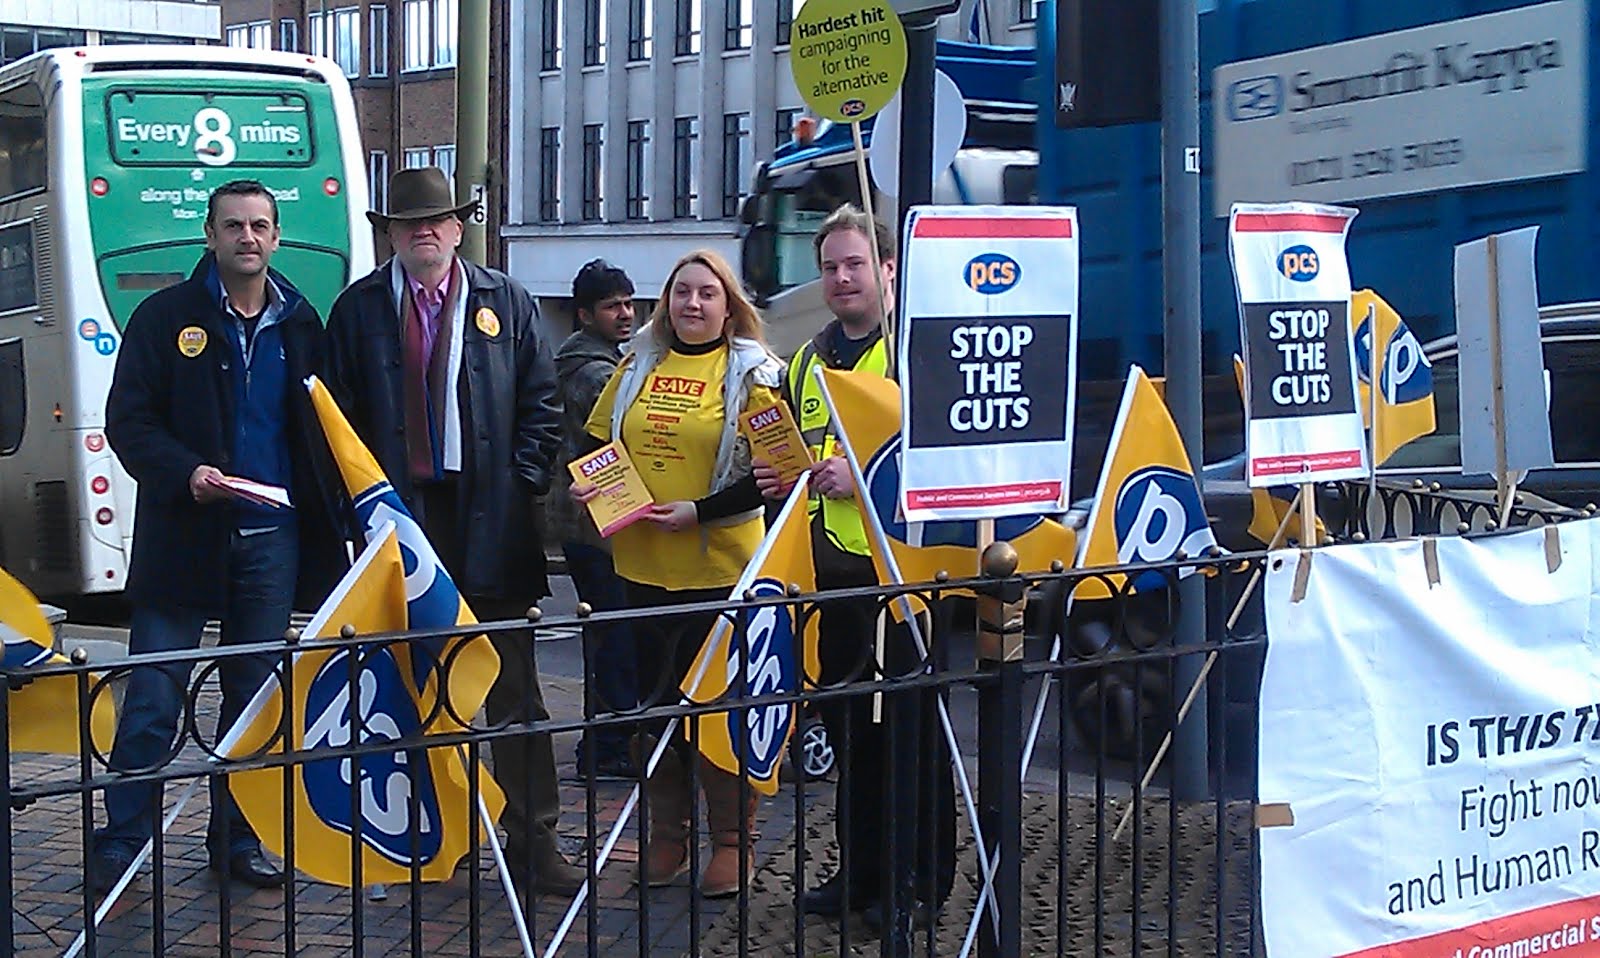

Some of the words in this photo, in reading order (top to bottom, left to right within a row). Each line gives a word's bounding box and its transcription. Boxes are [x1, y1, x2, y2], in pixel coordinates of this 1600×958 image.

[798, 13, 858, 39] Hardest
[861, 7, 885, 25] hit
[799, 28, 891, 58] campaigning
[822, 59, 841, 75] for
[844, 54, 870, 71] the
[812, 71, 888, 97] alternative
[842, 102, 864, 115] pcs
[118, 118, 190, 146] Every
[194, 107, 236, 166] 8
[240, 120, 300, 143] mins
[141, 188, 182, 204] along
[184, 187, 209, 201] the
[268, 187, 299, 201] oad
[970, 261, 1015, 292] pcs
[1283, 252, 1317, 278] pcs
[1269, 309, 1330, 341] STOP
[950, 325, 1033, 359] STOP
[1277, 342, 1326, 372] THE
[655, 379, 703, 396] SAVE
[959, 361, 1022, 394] THE
[1272, 374, 1331, 405] CUTS
[750, 408, 780, 430] SAVE
[950, 397, 1030, 432] CUTS
[583, 450, 617, 475] SAVE
[1427, 721, 1458, 766] IS
[1469, 711, 1565, 759] THIS
[1461, 779, 1543, 837] Fight
[1388, 859, 1446, 915] and
[1455, 845, 1572, 899] Human
[1468, 918, 1587, 958] Commercial
